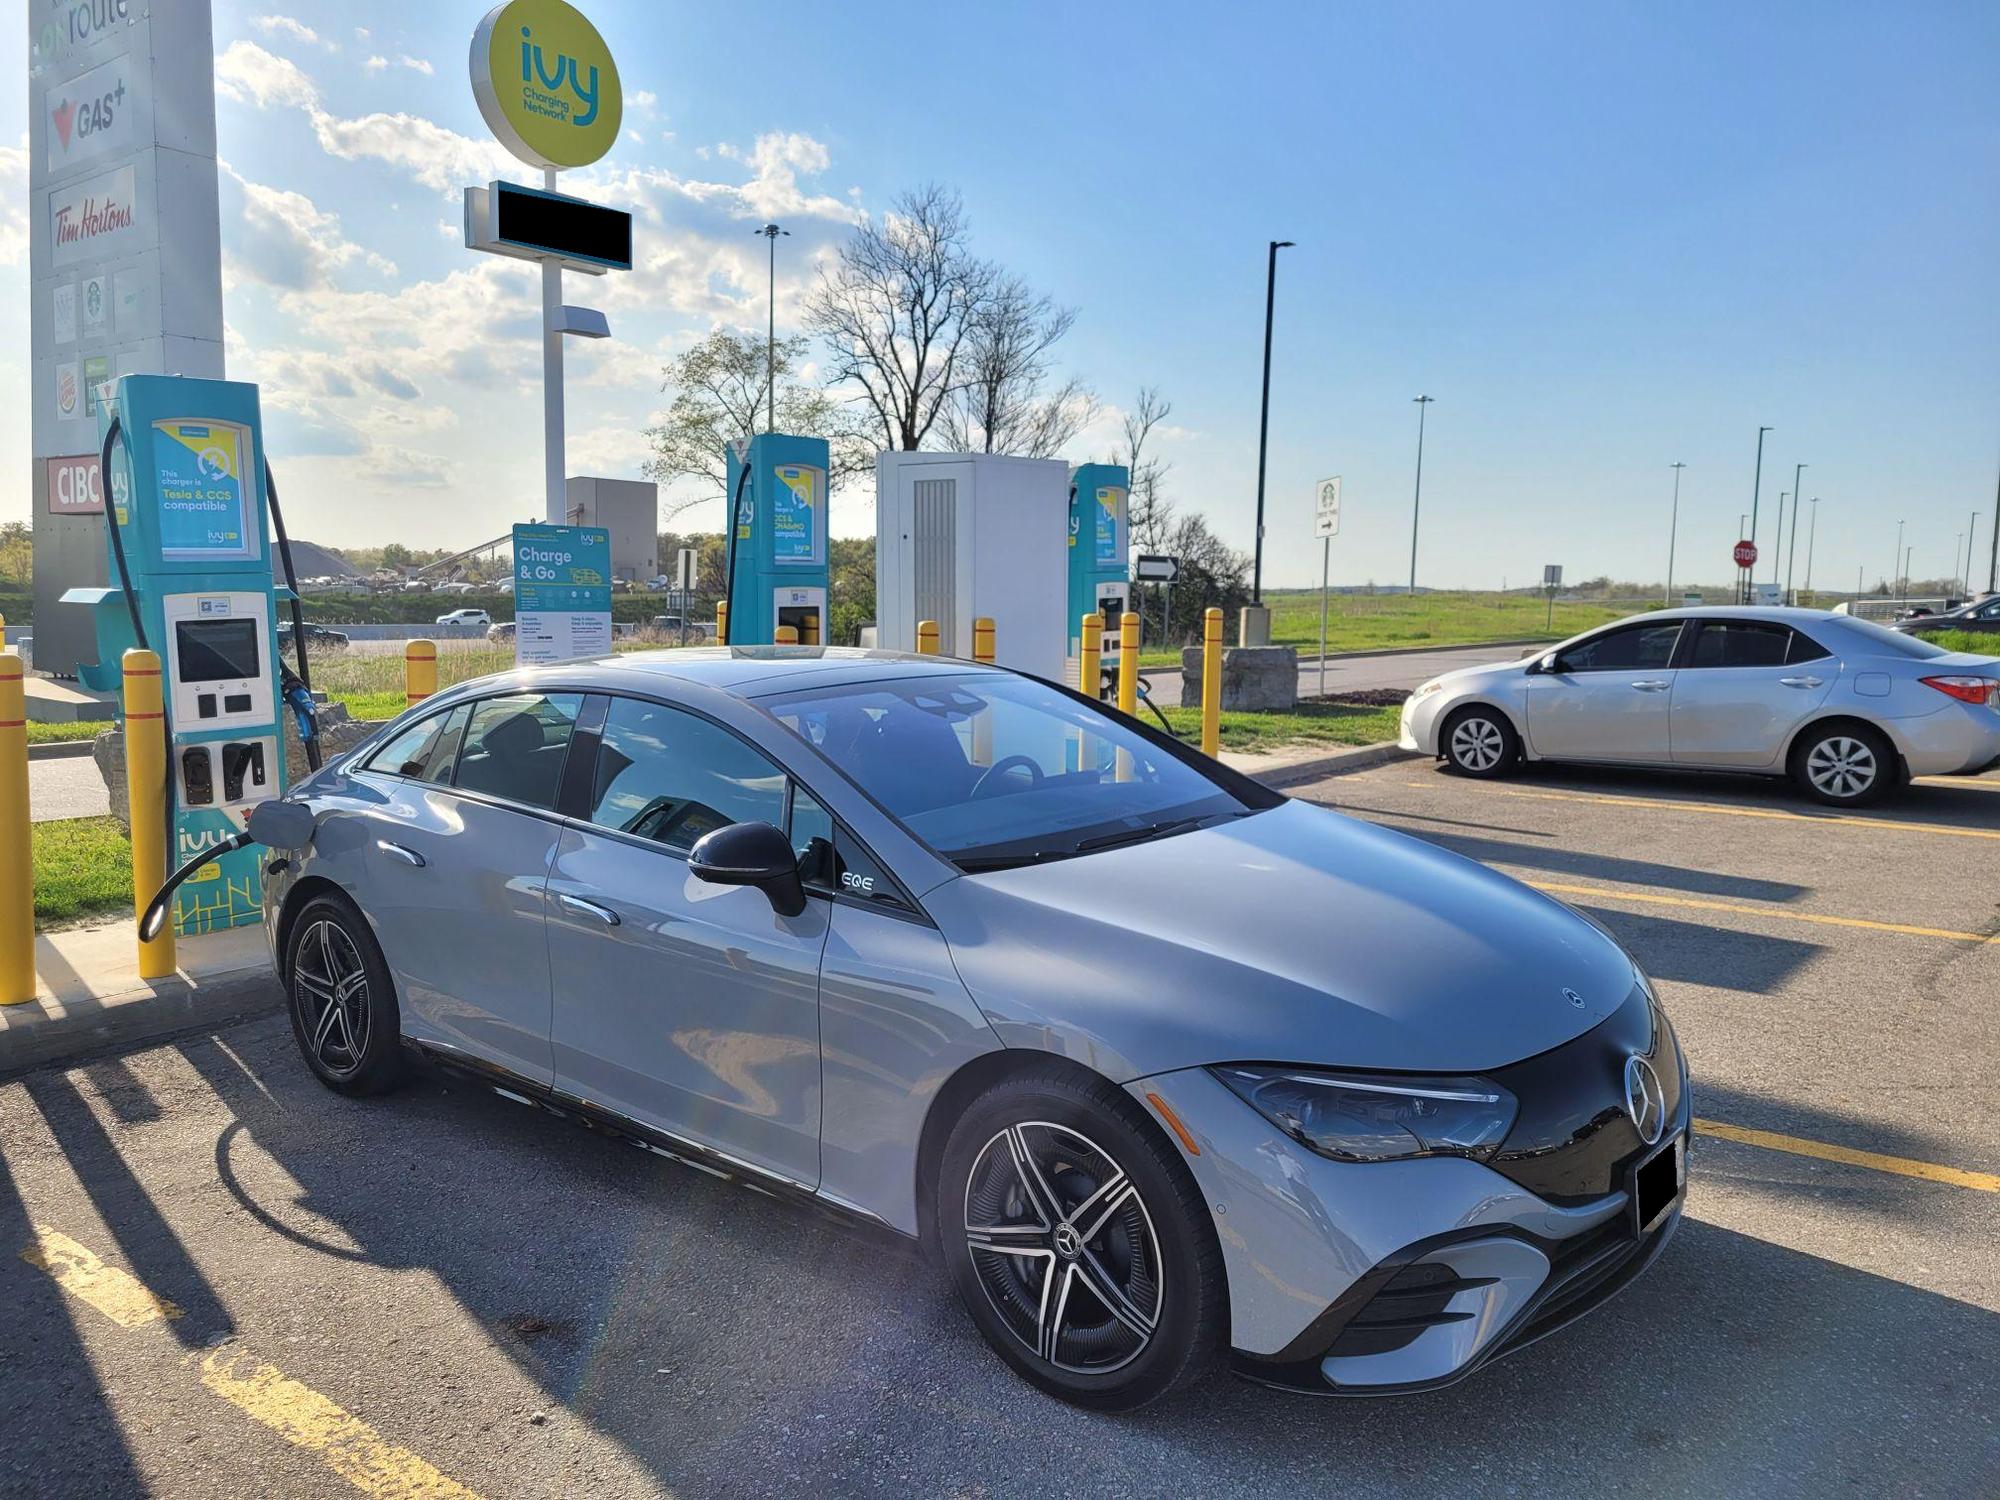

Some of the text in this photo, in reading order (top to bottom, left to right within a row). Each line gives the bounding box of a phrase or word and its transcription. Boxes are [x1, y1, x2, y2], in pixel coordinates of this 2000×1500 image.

[521, 26, 598, 126] ivy
[523, 87, 569, 113] Charging
[523, 100, 566, 122] Network
[56, 198, 132, 246] Tim Hortons
[161, 469, 178, 478] This
[57, 464, 100, 504] CIBC
[161, 478, 201, 487] charger is
[163, 489, 232, 501] Tesla & CCS
[163, 500, 227, 512] compatible
[580, 532, 594, 545] ivy
[519, 547, 572, 565] Charge
[1735, 548, 1756, 560] STOP
[520, 565, 556, 579] & Go
[841, 872, 874, 890] EQE
